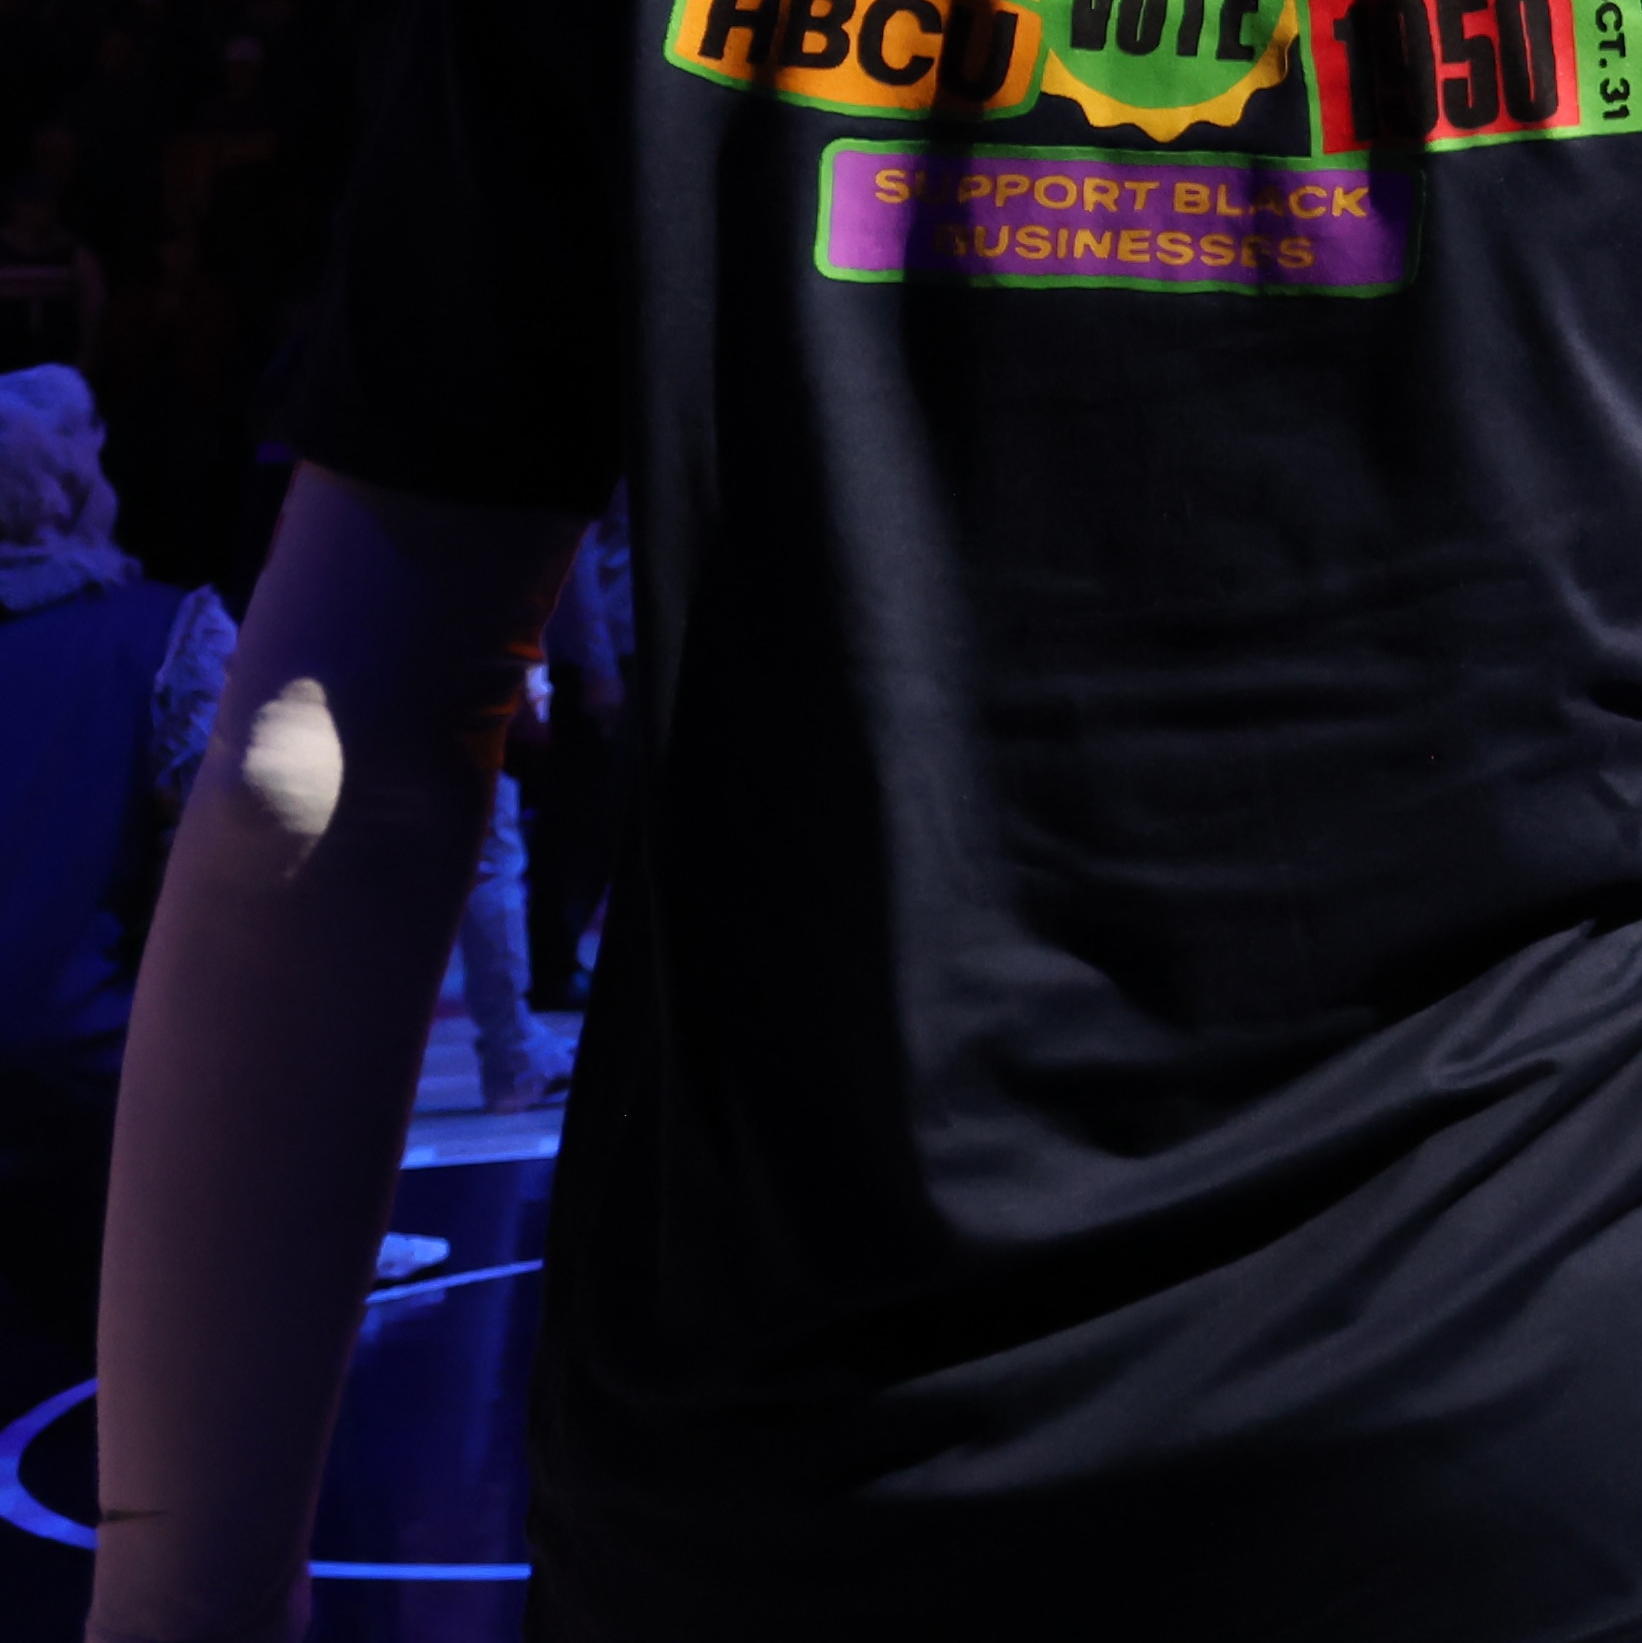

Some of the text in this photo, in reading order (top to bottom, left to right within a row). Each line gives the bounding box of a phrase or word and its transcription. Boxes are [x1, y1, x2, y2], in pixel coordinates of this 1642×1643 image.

[874, 168, 1370, 220] SUPPORT BLACK
[932, 224, 1316, 270] BUSINESSES
